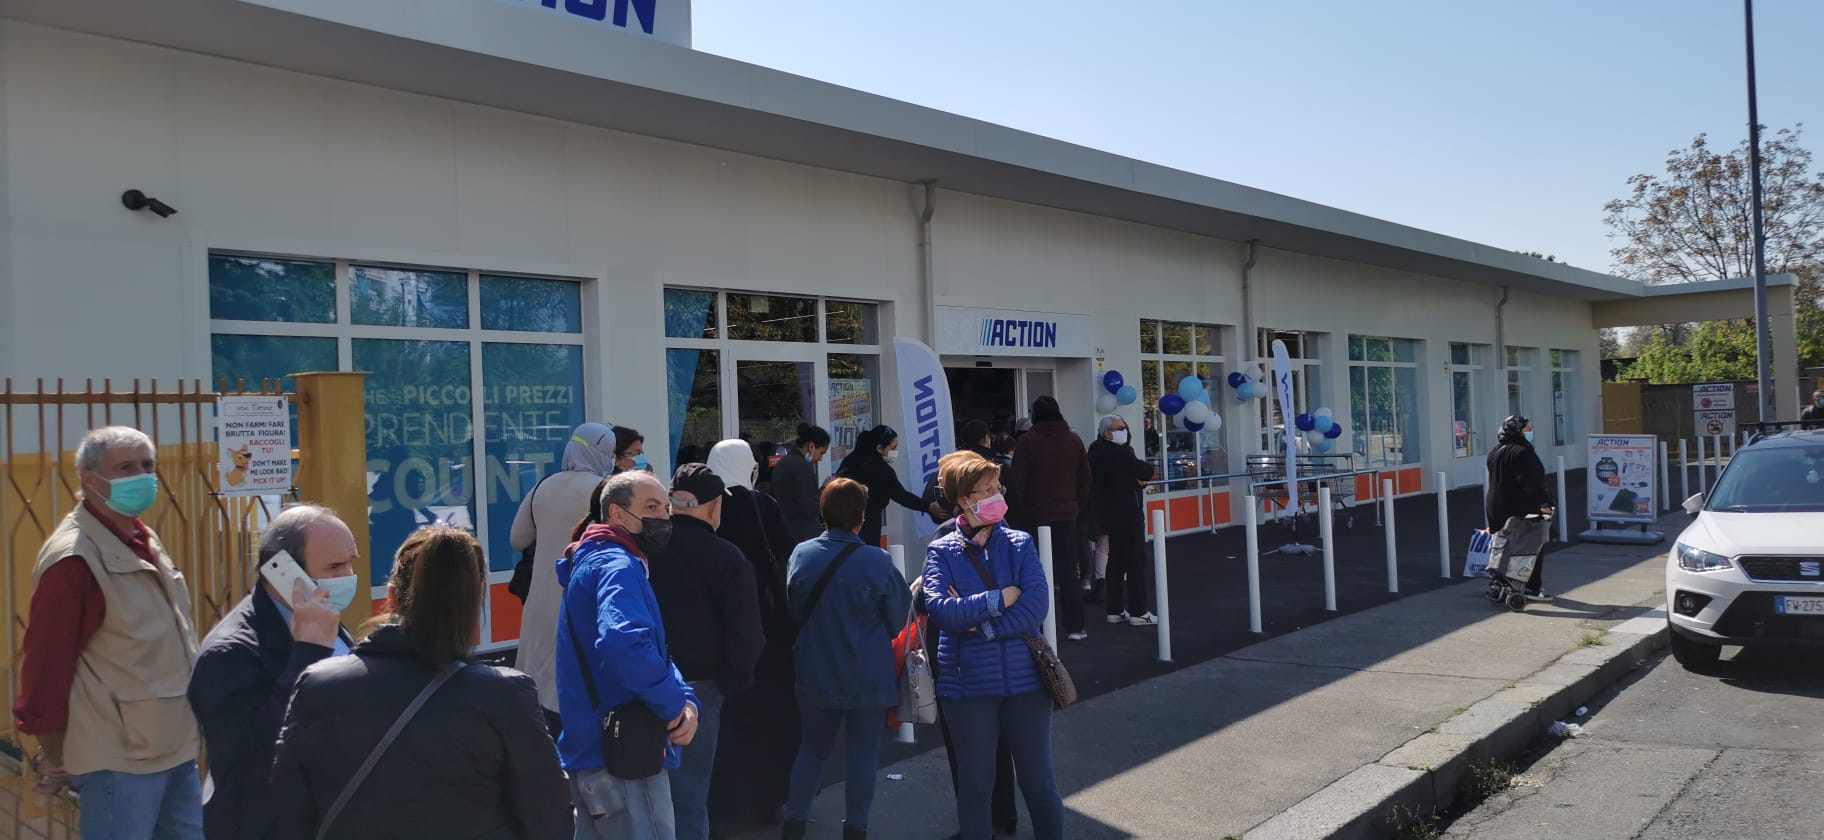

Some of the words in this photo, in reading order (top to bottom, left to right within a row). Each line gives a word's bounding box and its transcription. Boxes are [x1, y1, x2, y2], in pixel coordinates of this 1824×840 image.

[991, 319, 1056, 348] ACTION
[506, 385, 573, 404] PREZZI
[1701, 411, 1733, 419] ACTION
[913, 374, 940, 484] CTION
[1802, 600, 1824, 611] 275
